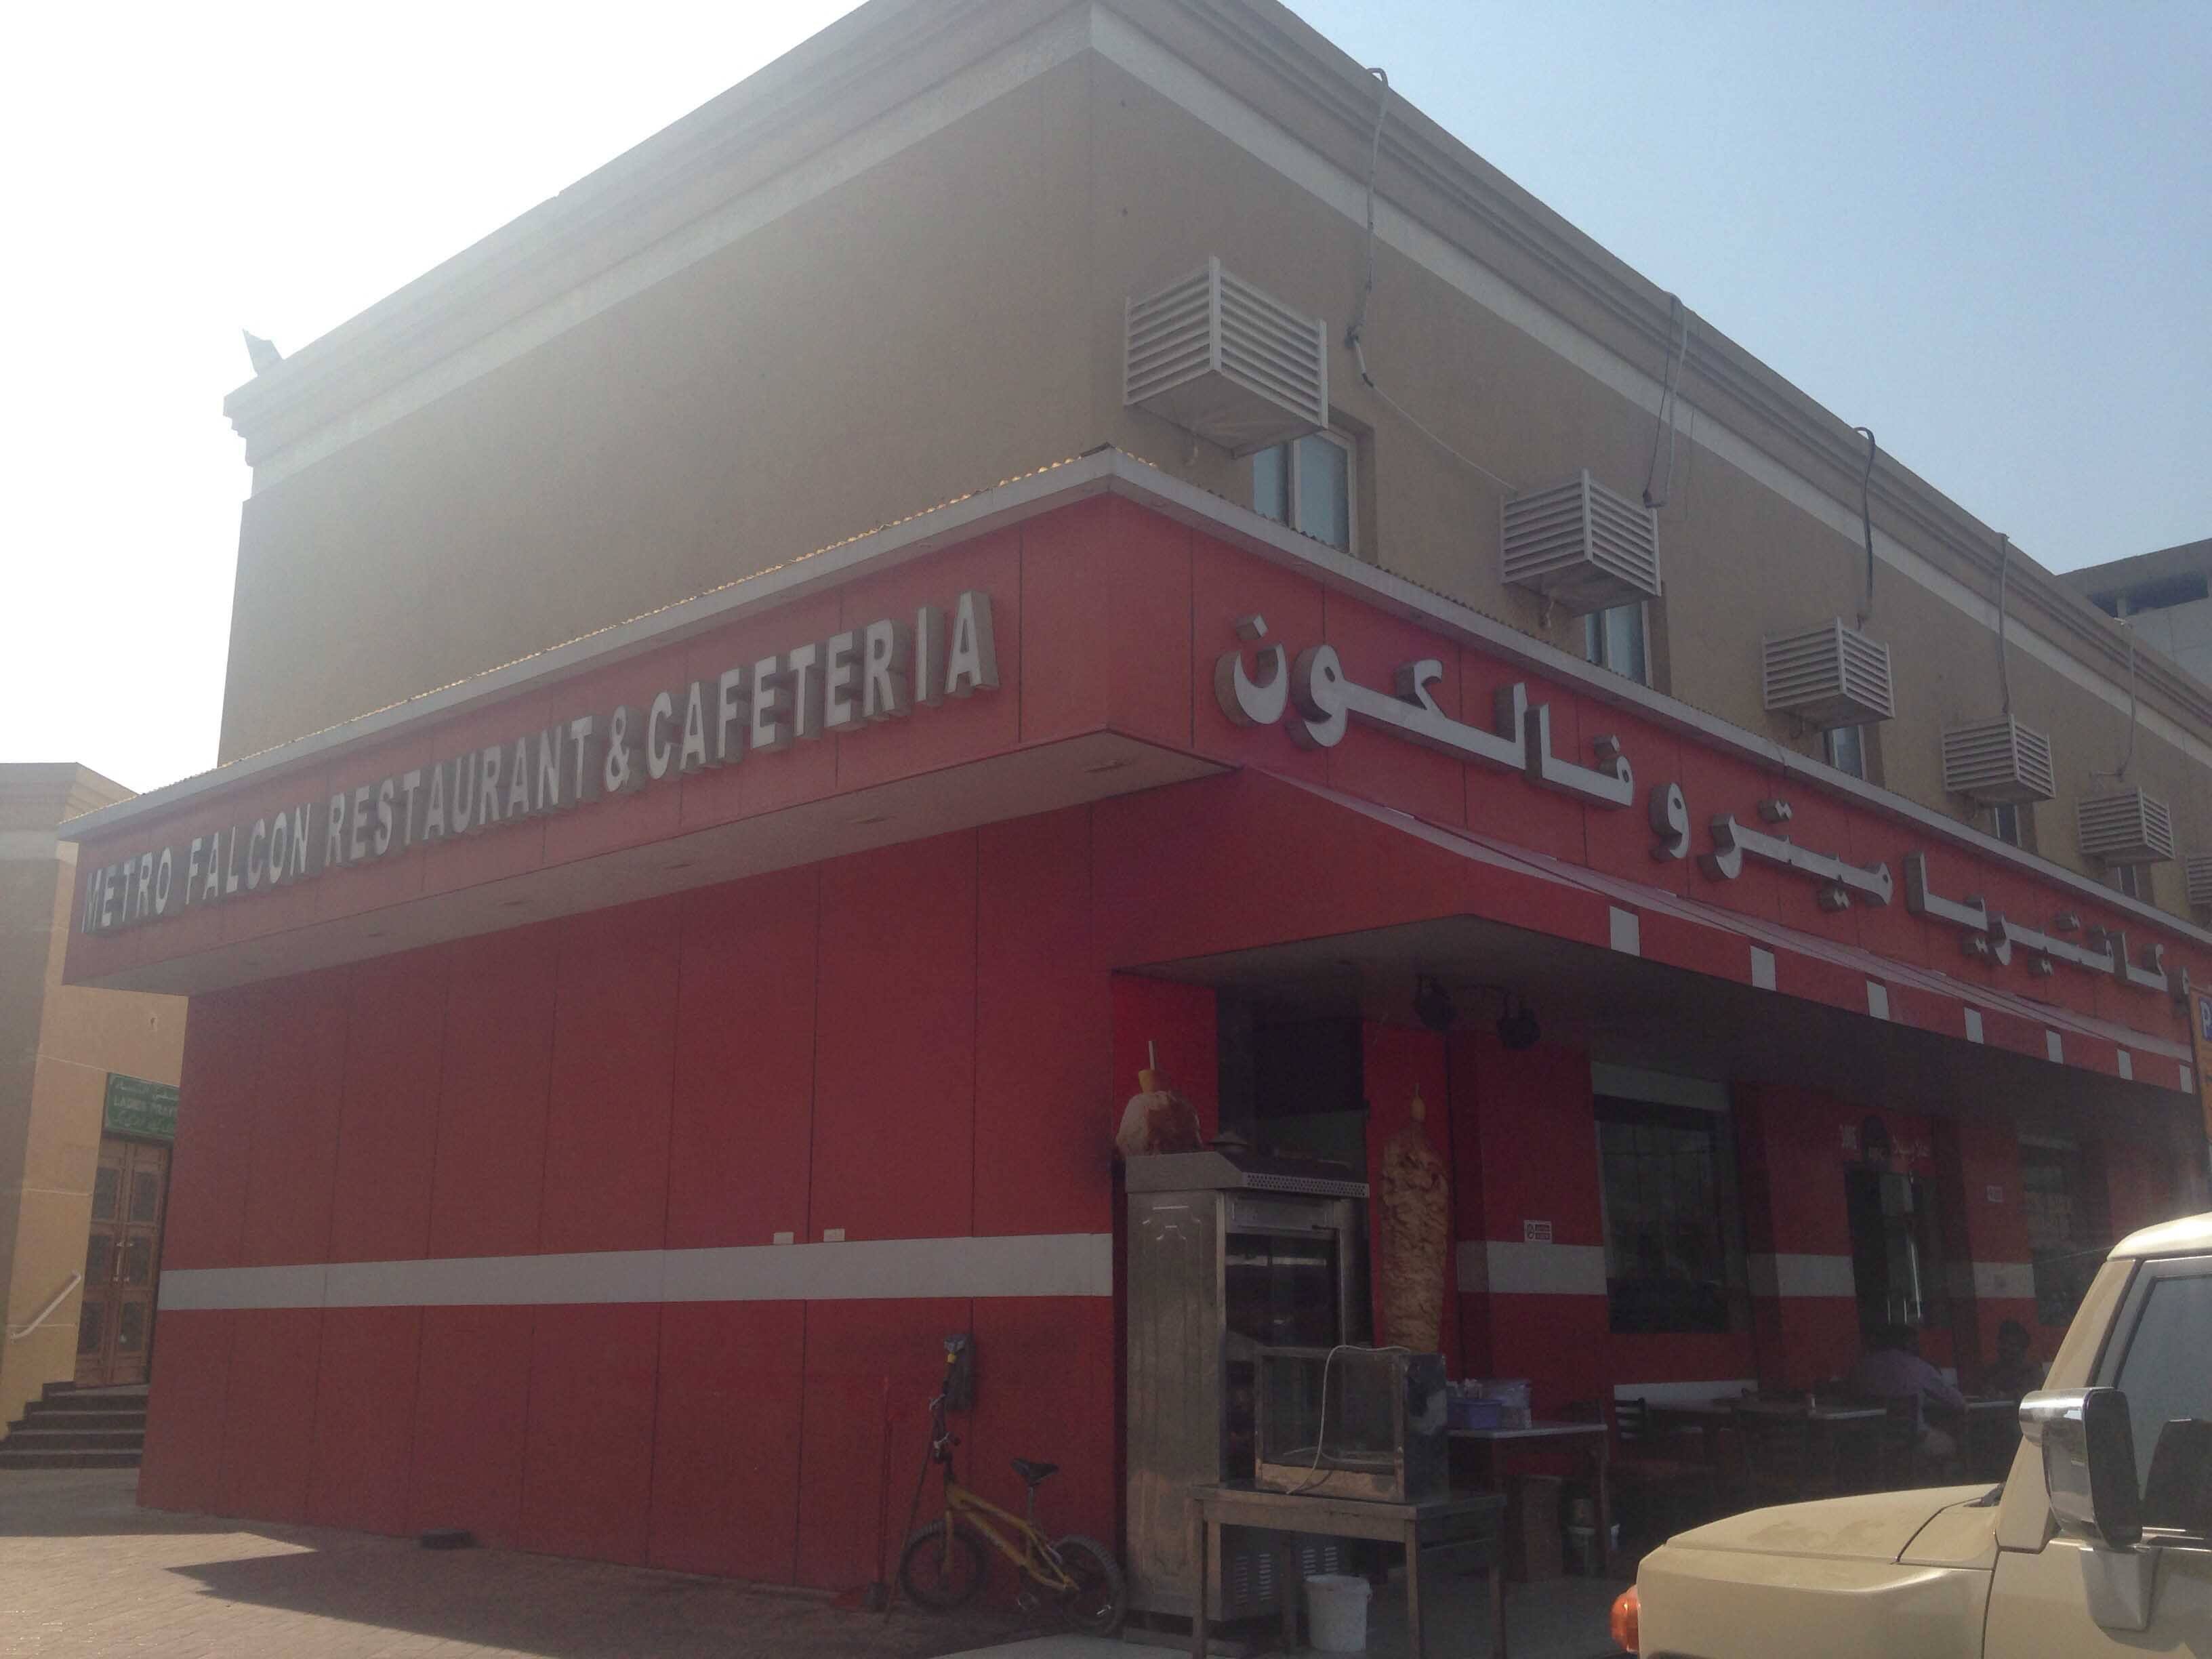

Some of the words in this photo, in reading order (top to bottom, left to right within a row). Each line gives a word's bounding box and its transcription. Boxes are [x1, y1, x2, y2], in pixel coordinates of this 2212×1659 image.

[81, 846, 173, 934] METRO
[185, 803, 312, 905] FALCON
[325, 715, 594, 867] RESTAURANT
[604, 704, 632, 792] &
[647, 590, 986, 781] CAFETERIA
[1216, 614, 1634, 807] فالكون
[1905, 851, 2168, 993] كافتيريا
